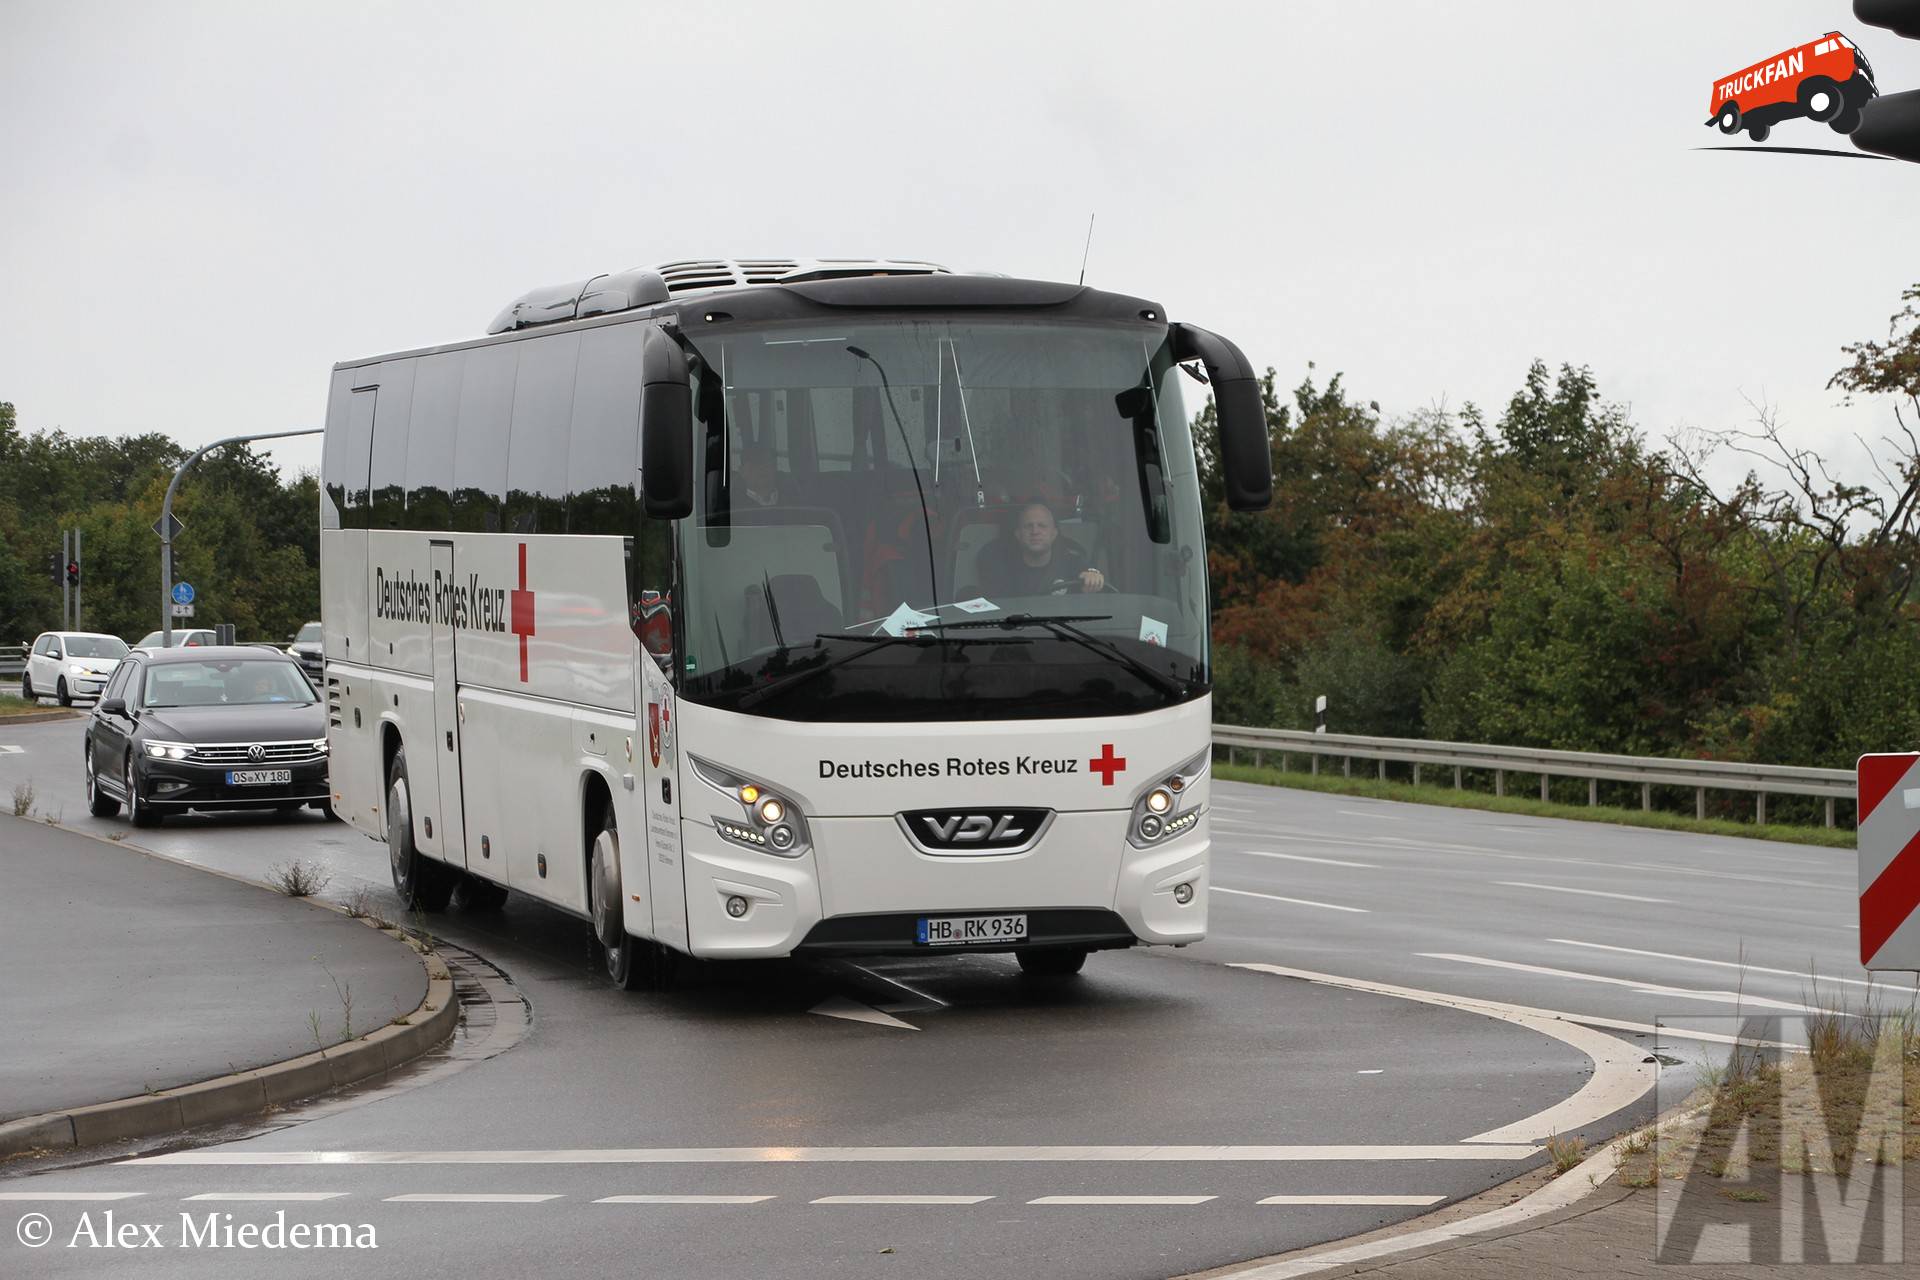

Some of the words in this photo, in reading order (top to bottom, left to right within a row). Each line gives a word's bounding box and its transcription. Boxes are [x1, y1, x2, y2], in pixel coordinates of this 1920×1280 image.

[376, 566, 431, 625] Deutsches
[434, 569, 468, 630] Rotes
[469, 573, 506, 633] Kreuz
[233, 773, 247, 783] OS
[254, 771, 268, 783] XY
[271, 771, 290, 782] 180
[818, 758, 941, 779] Deutsches
[946, 757, 1011, 777] Rotes
[1015, 755, 1079, 775] Kreuz
[922, 814, 1025, 842] VDL
[929, 921, 952, 939] HB
[964, 919, 988, 938] RK
[991, 917, 1025, 937] 936
